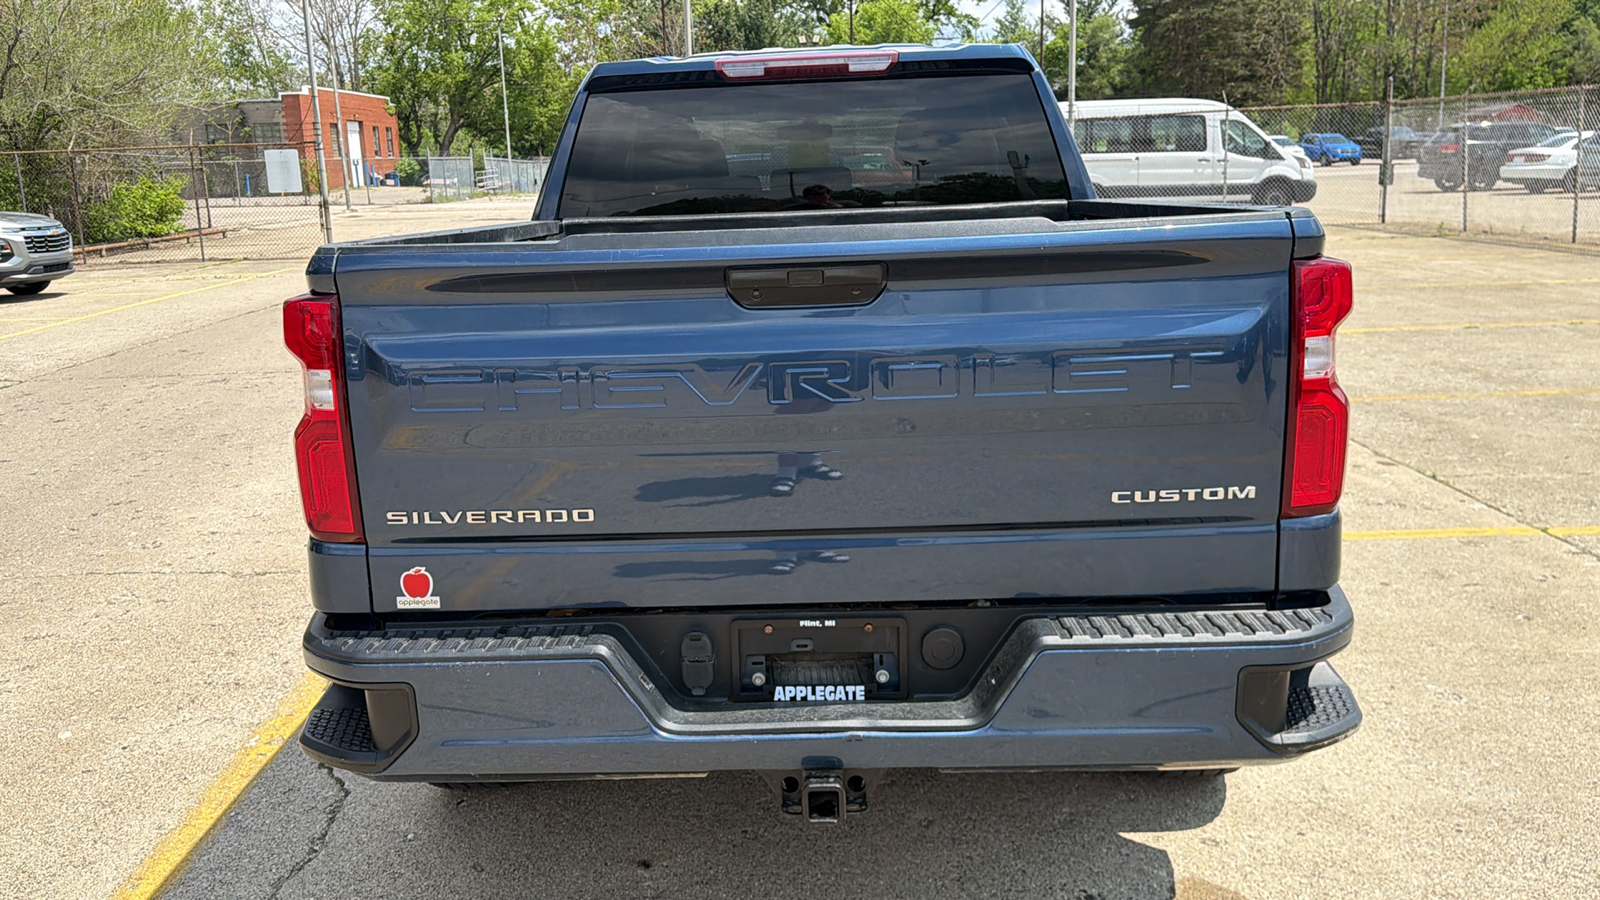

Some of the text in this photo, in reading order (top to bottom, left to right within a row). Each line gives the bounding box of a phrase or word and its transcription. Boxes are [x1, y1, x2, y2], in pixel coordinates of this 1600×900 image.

[407, 344, 1225, 413] CHEVROLET
[1111, 485, 1256, 504] CUSTOM
[386, 508, 596, 525] SILVERADO
[398, 598, 439, 607] applegate
[799, 619, 836, 628] Flint, MI
[773, 685, 866, 702] APPLEGATE
